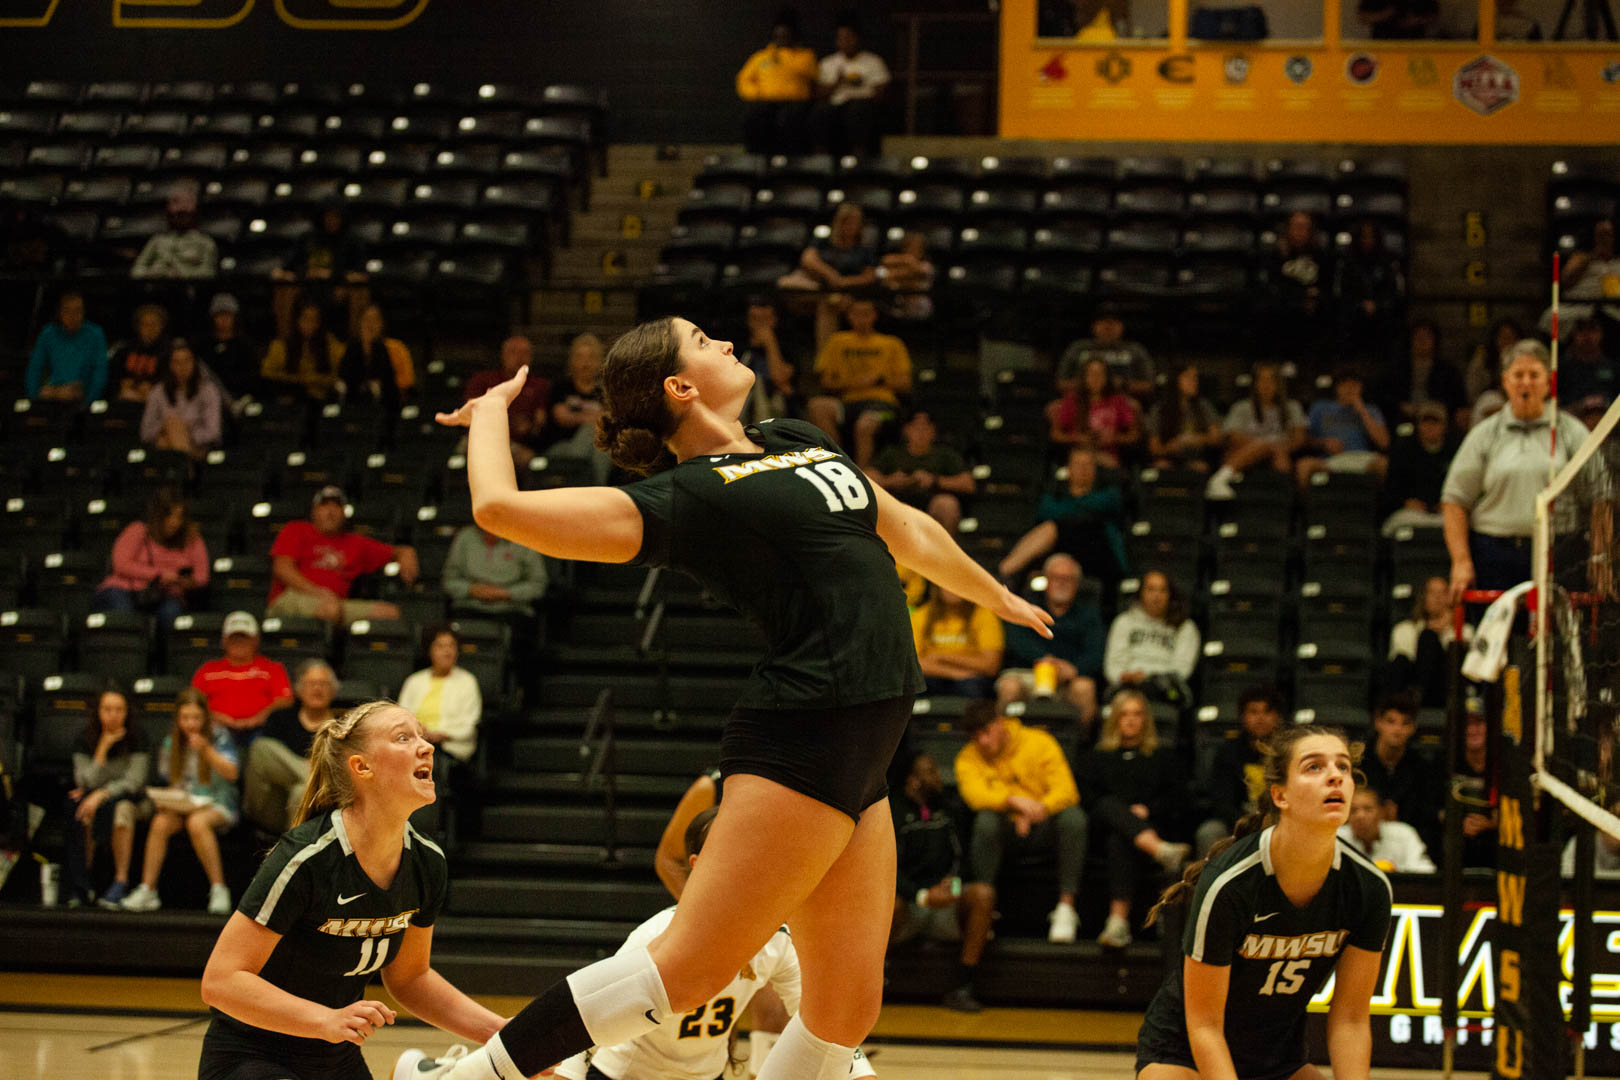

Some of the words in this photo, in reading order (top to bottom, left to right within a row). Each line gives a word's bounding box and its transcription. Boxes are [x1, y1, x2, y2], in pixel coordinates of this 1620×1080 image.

[712, 446, 843, 485] MWS
[795, 460, 870, 513] 18
[343, 937, 390, 977] 11
[1238, 928, 1351, 959] MWSU
[1258, 959, 1312, 996] 15
[677, 995, 737, 1041] 23
